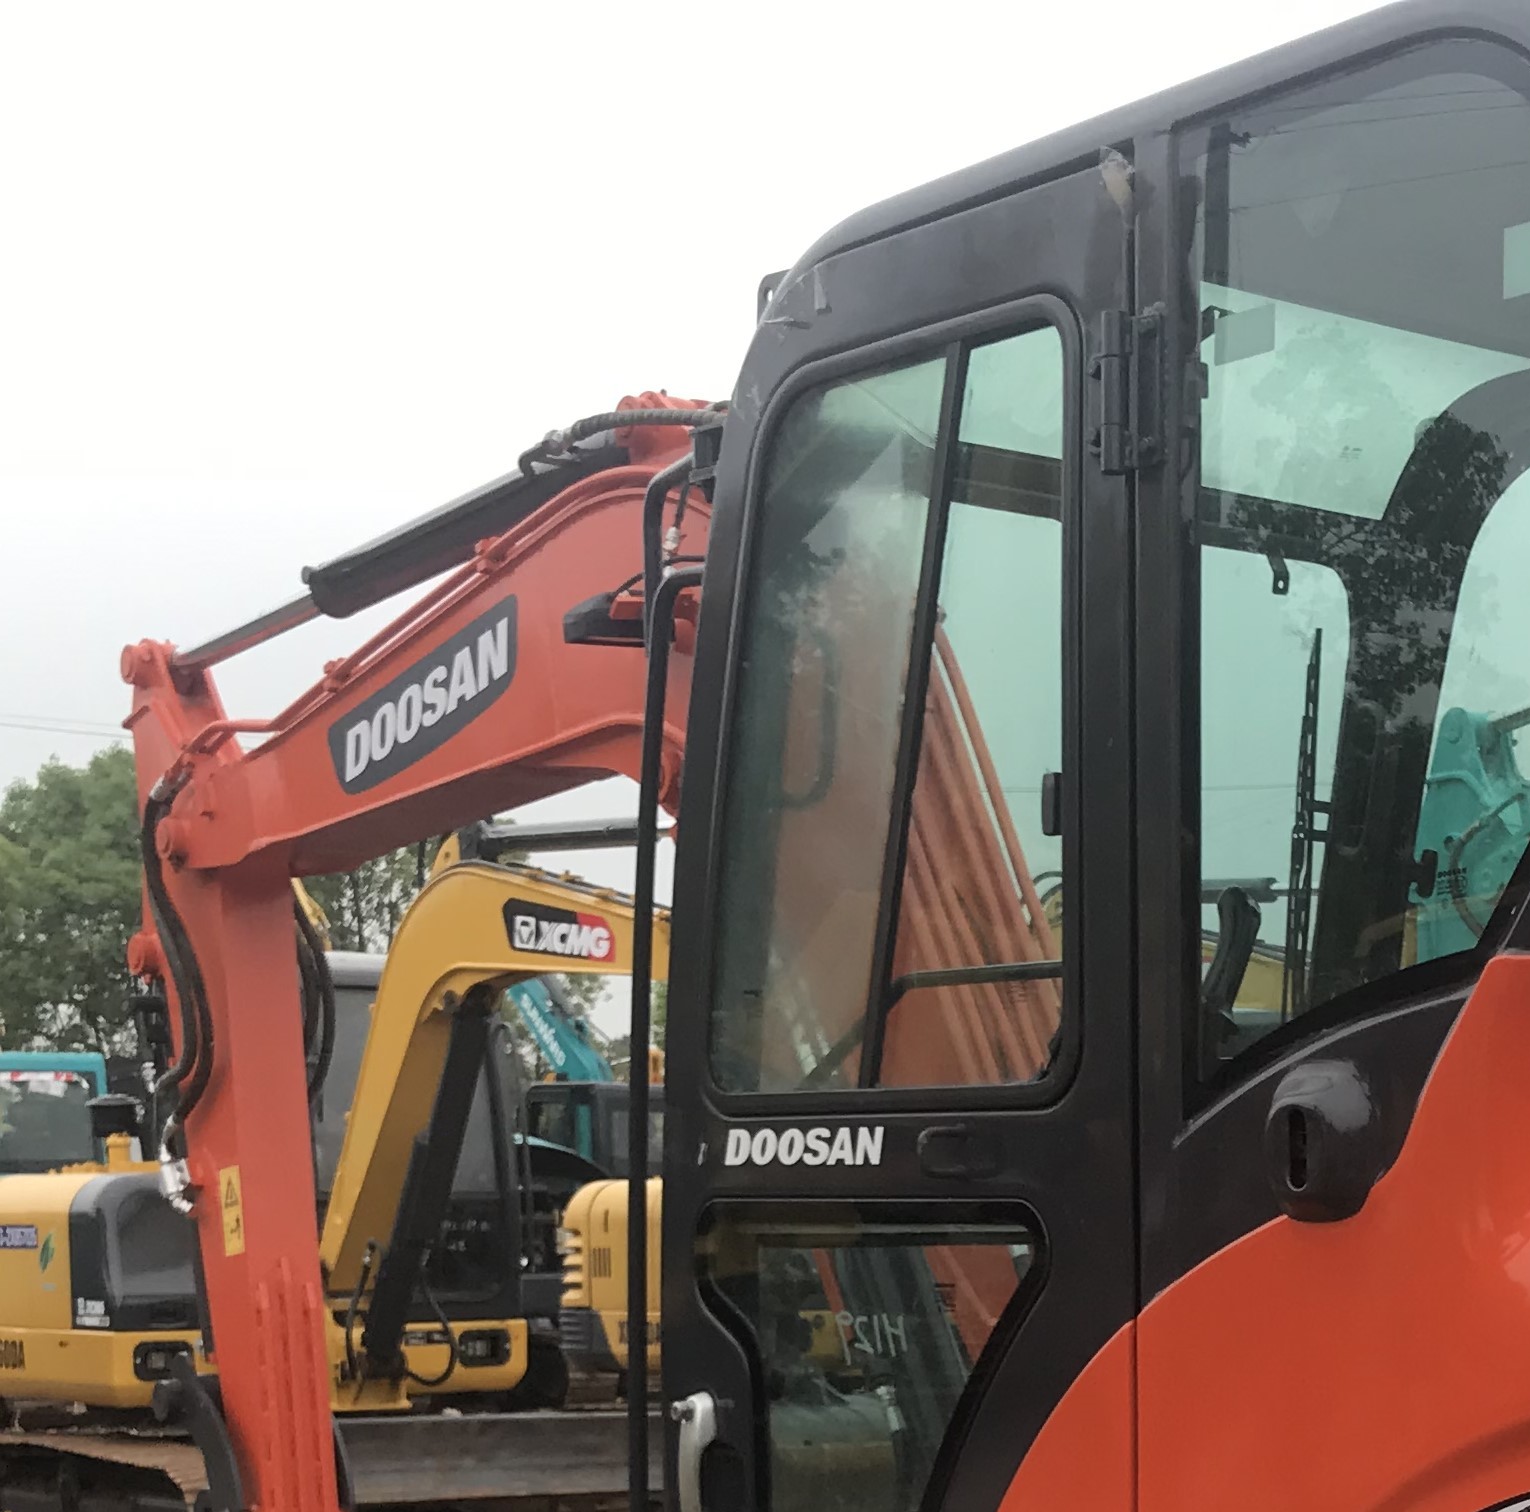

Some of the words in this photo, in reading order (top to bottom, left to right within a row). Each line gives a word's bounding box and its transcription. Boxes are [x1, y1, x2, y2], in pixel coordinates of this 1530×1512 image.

[345, 616, 508, 783] DOOSAN
[535, 919, 611, 959] XCMG
[724, 1126, 885, 1166] DOOSAN
